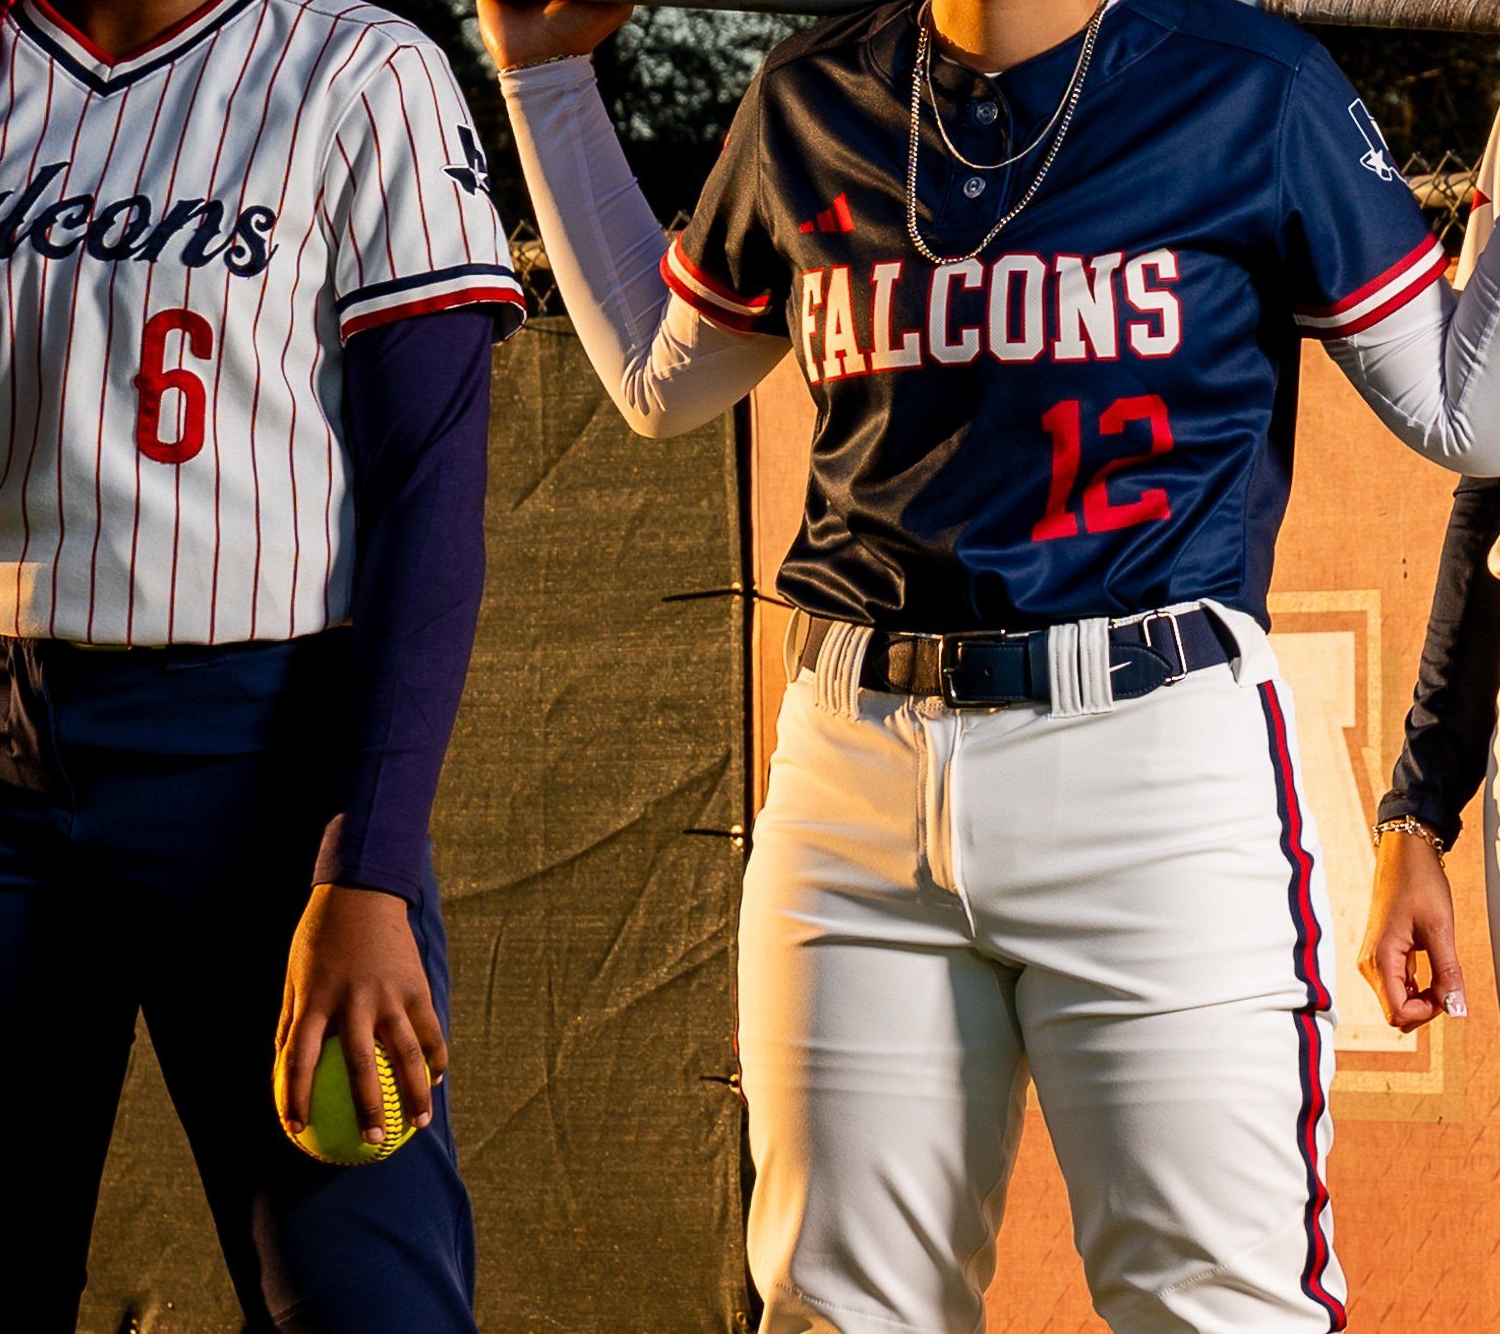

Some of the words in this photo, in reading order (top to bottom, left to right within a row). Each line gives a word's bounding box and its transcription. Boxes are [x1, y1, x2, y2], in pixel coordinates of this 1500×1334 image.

[134, 308, 213, 464] 6
[802, 248, 1182, 386] FALCONS
[1031, 395, 1174, 542] 12
